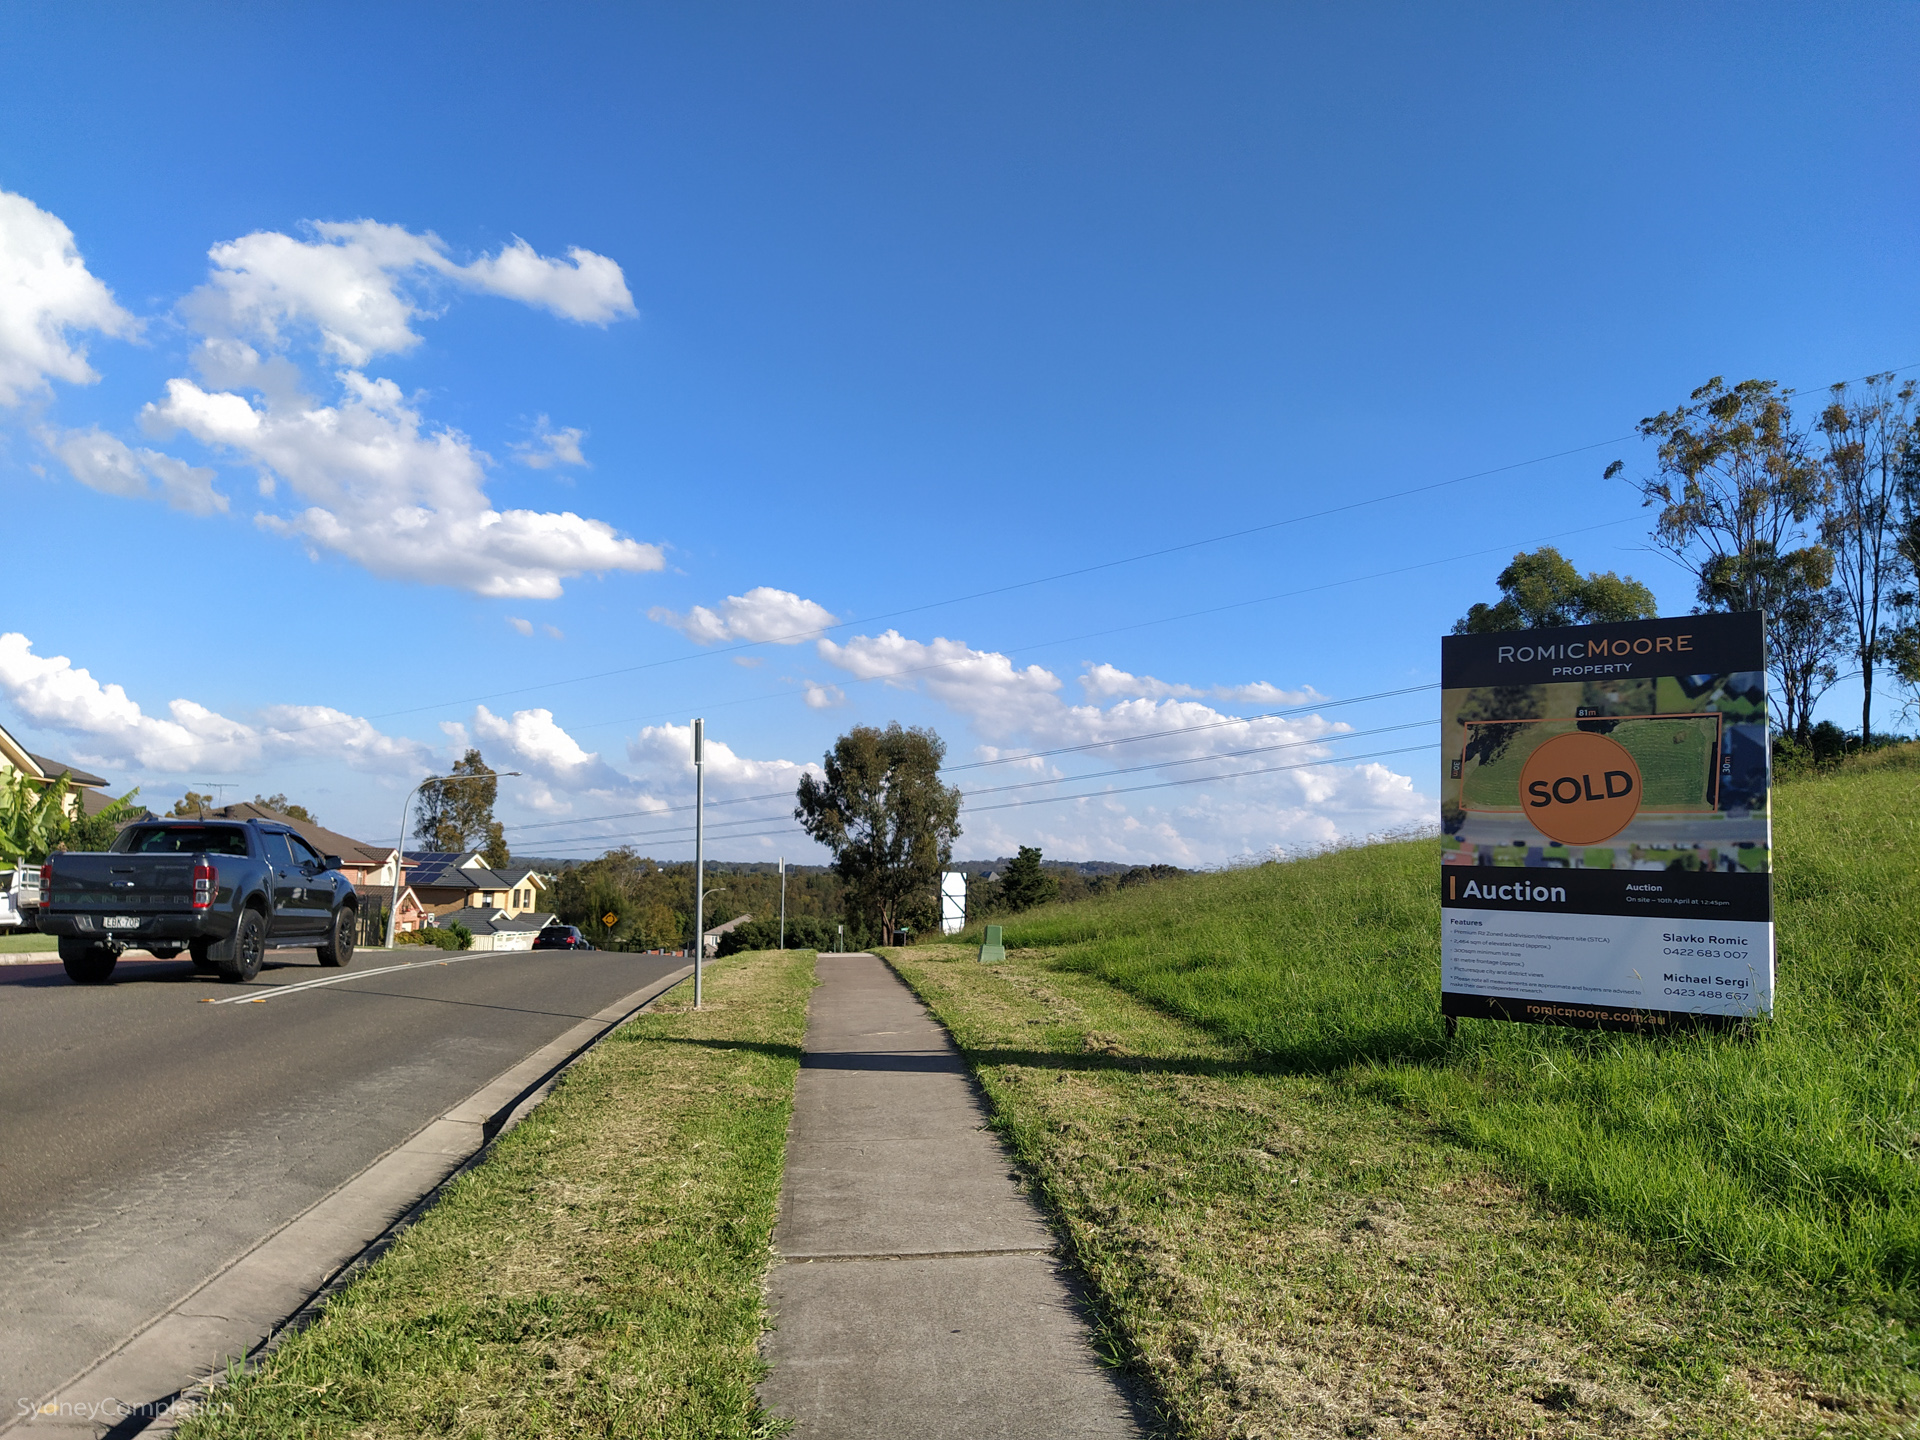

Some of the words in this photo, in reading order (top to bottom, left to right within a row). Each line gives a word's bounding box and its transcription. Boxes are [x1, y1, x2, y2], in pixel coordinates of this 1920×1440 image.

[1498, 635, 1693, 664] ROMICMOORE
[1552, 663, 1633, 676] PROPERTY
[1578, 709, 1597, 717] 81m
[1722, 756, 1731, 773] 30m
[1528, 770, 1633, 808] SOLD
[1463, 880, 1566, 902] Auction
[1626, 883, 1663, 892] Auction
[54, 894, 190, 904] RANGER
[1450, 918, 1483, 926] Features
[1663, 933, 1704, 943] Slavko
[1708, 936, 1748, 945] Romic
[1663, 947, 1694, 957] 0422
[1697, 949, 1720, 958] 683
[1723, 951, 1748, 959] 007
[1476, 958, 1499, 966] frontage
[1454, 966, 1485, 974] Picturesque
[1664, 973, 1711, 984] Michael
[1715, 976, 1749, 989] Sergi
[1664, 987, 1695, 997] 0423
[1698, 990, 1722, 999] 488
[1527, 1004, 1666, 1025] romicmoore.com.au
